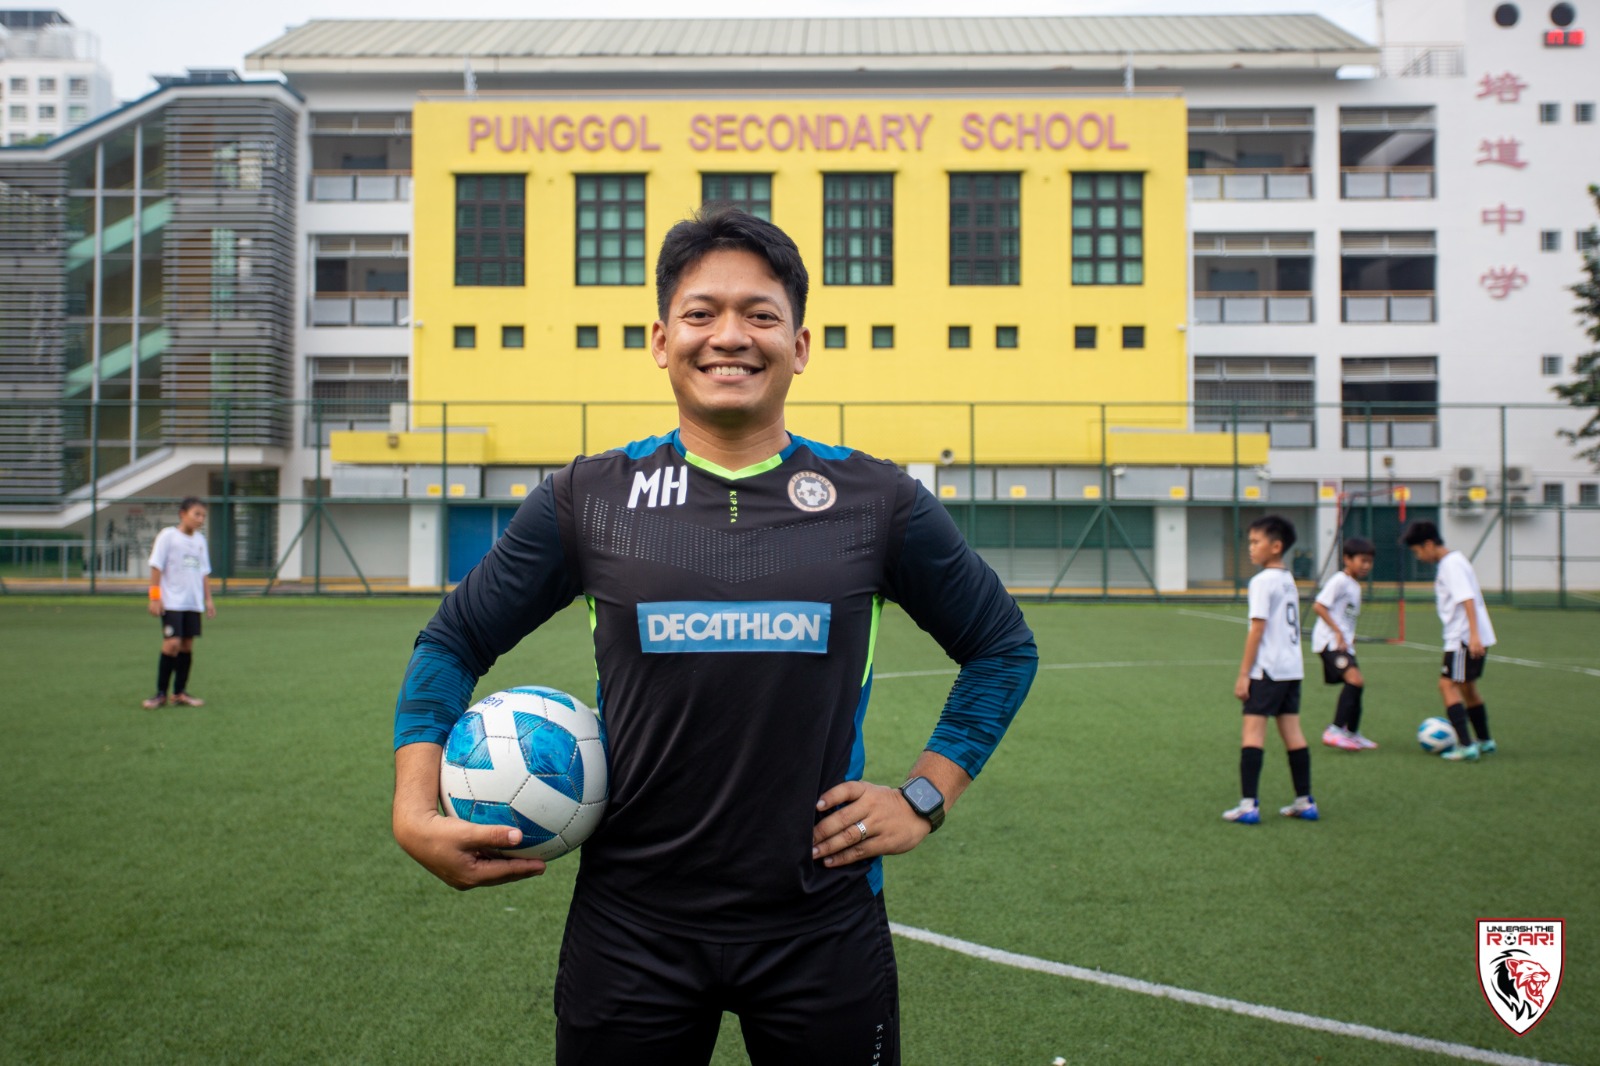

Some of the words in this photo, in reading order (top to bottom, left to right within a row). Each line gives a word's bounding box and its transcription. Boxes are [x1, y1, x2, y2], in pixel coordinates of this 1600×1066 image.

[468, 114, 661, 152] PUNGGOL
[689, 114, 933, 152] SECONDARY
[960, 112, 1129, 151] SCHOOL
[627, 465, 688, 508] MH
[730, 490, 738, 523] KIPSTA
[647, 612, 821, 641] DECATHLON
[1286, 602, 1299, 645] 9
